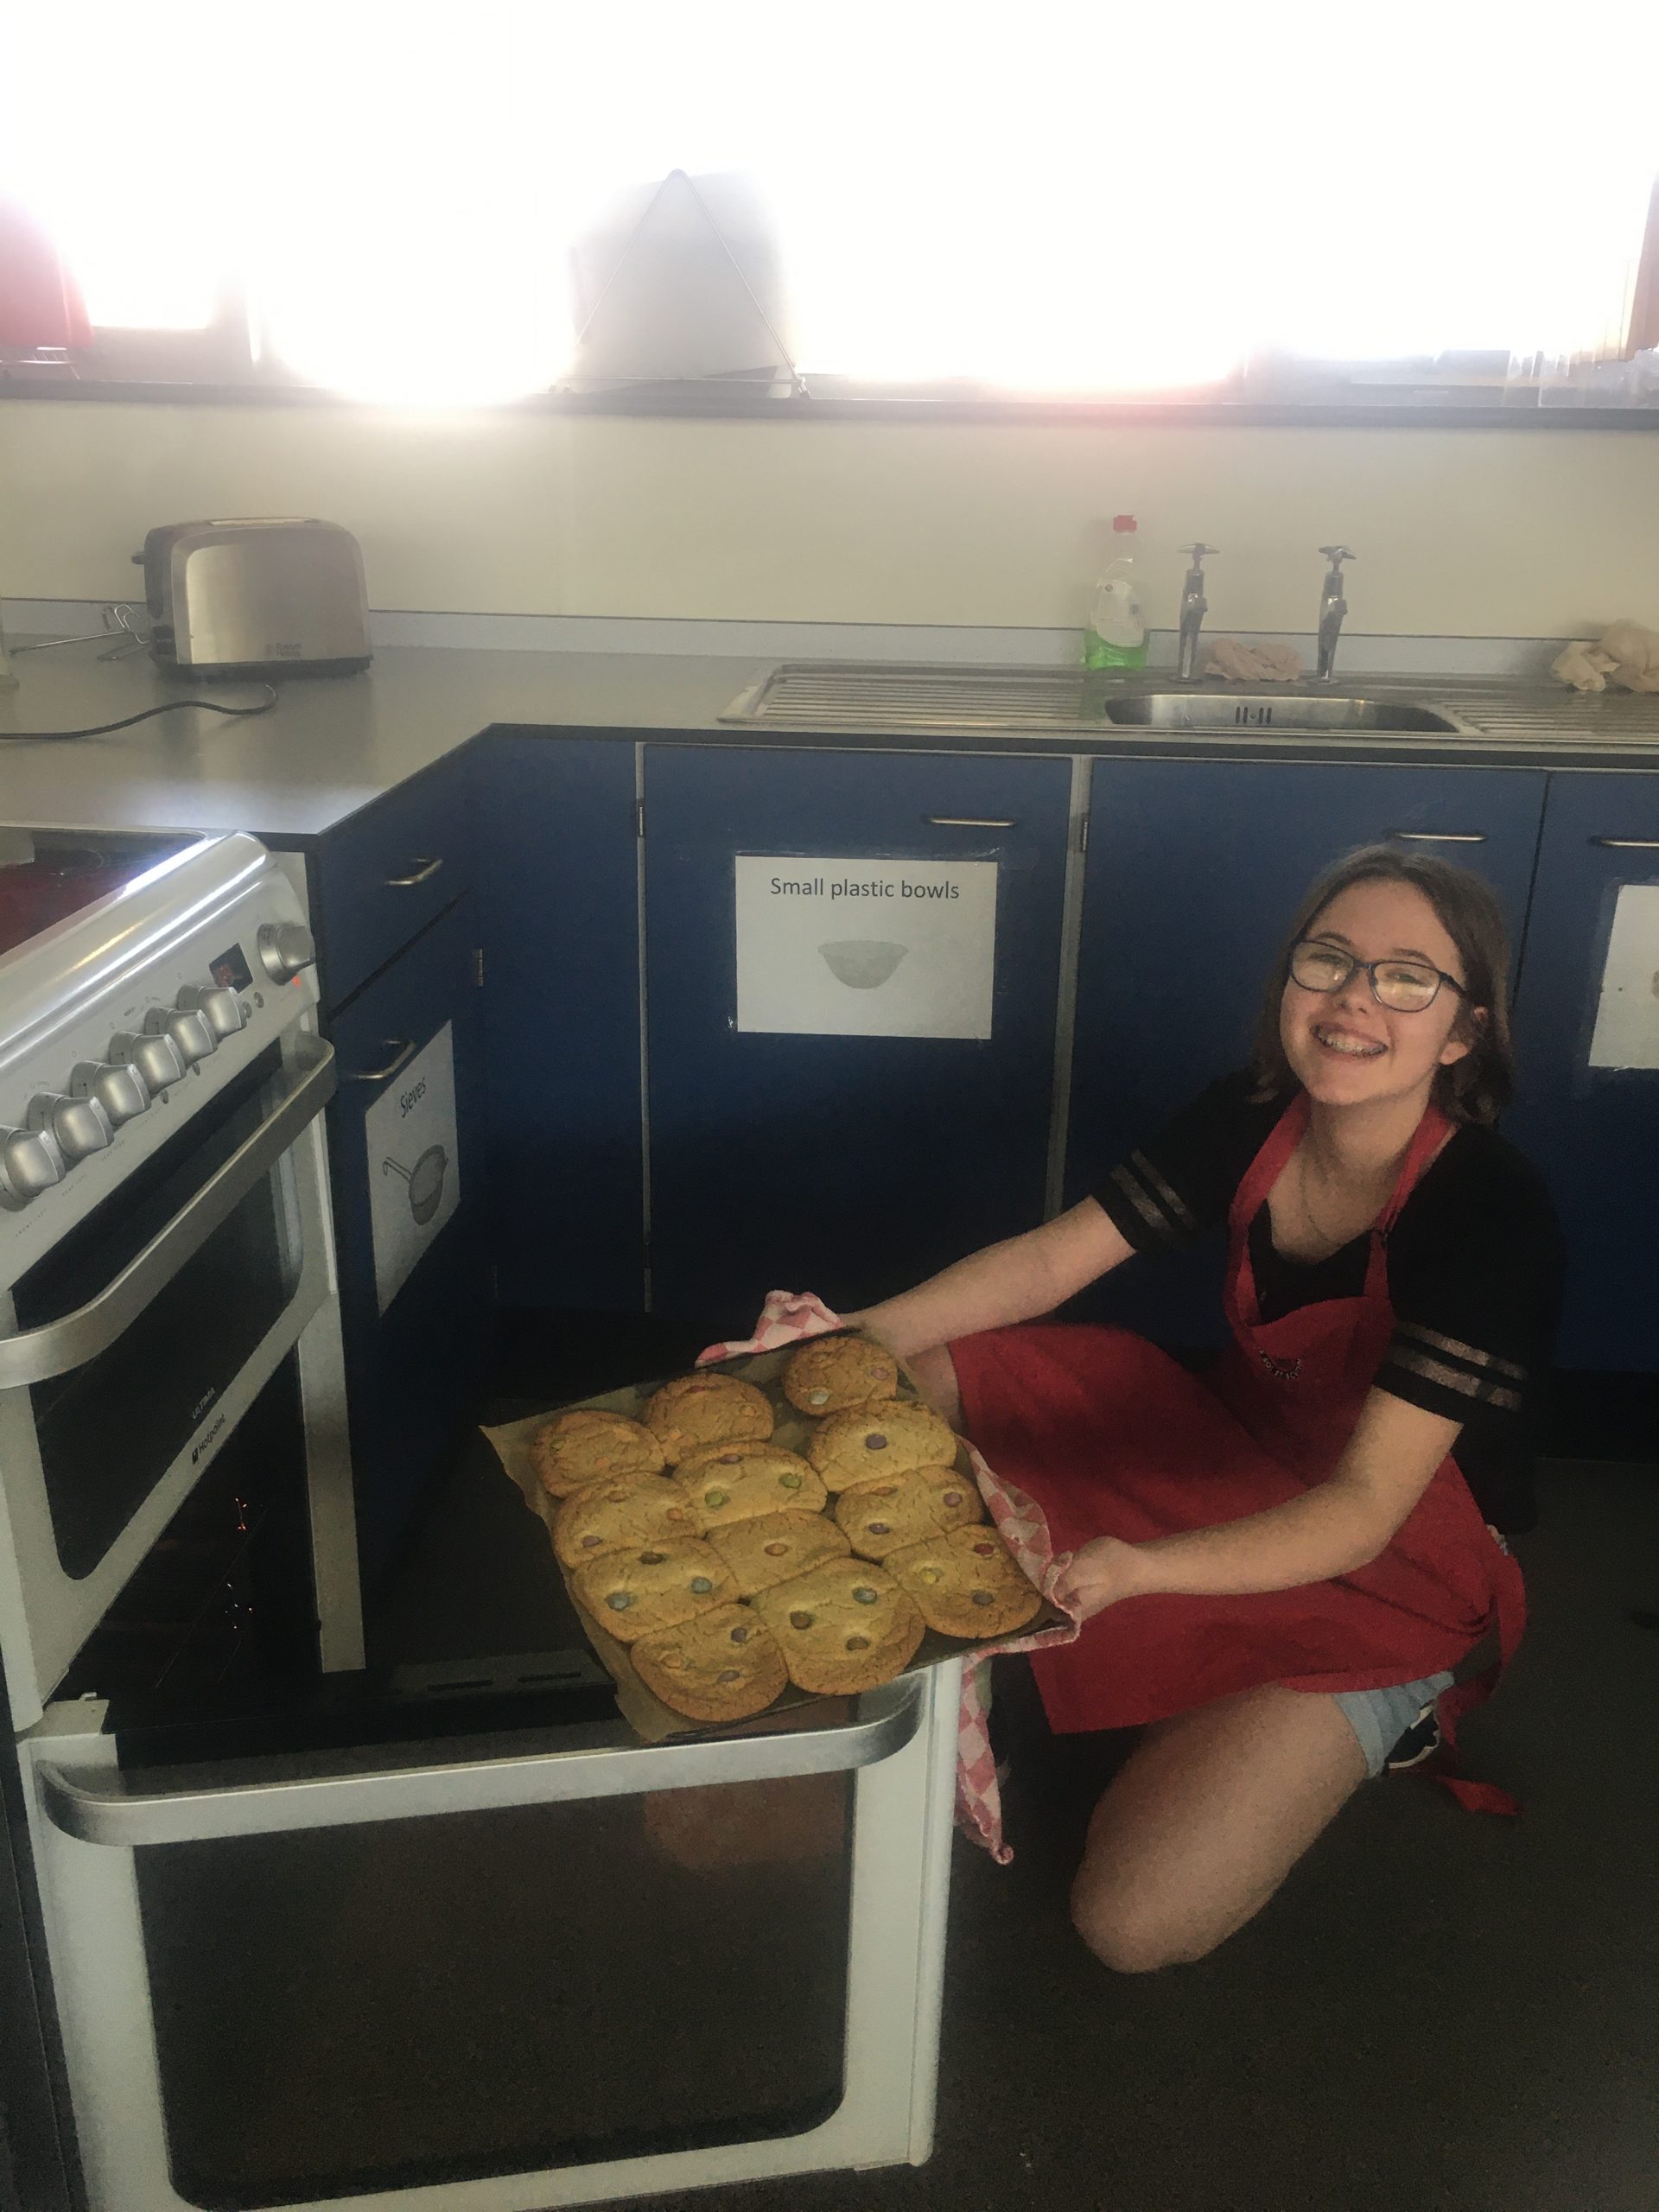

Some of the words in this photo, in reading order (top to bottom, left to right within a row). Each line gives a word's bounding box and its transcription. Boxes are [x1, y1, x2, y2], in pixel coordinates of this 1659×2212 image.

[770, 877, 823, 896] Small
[830, 879, 894, 899] plastic
[901, 880, 960, 899] bowls
[400, 1077, 427, 1118] Sieves
[199, 1414, 226, 1452] Hotpoint
